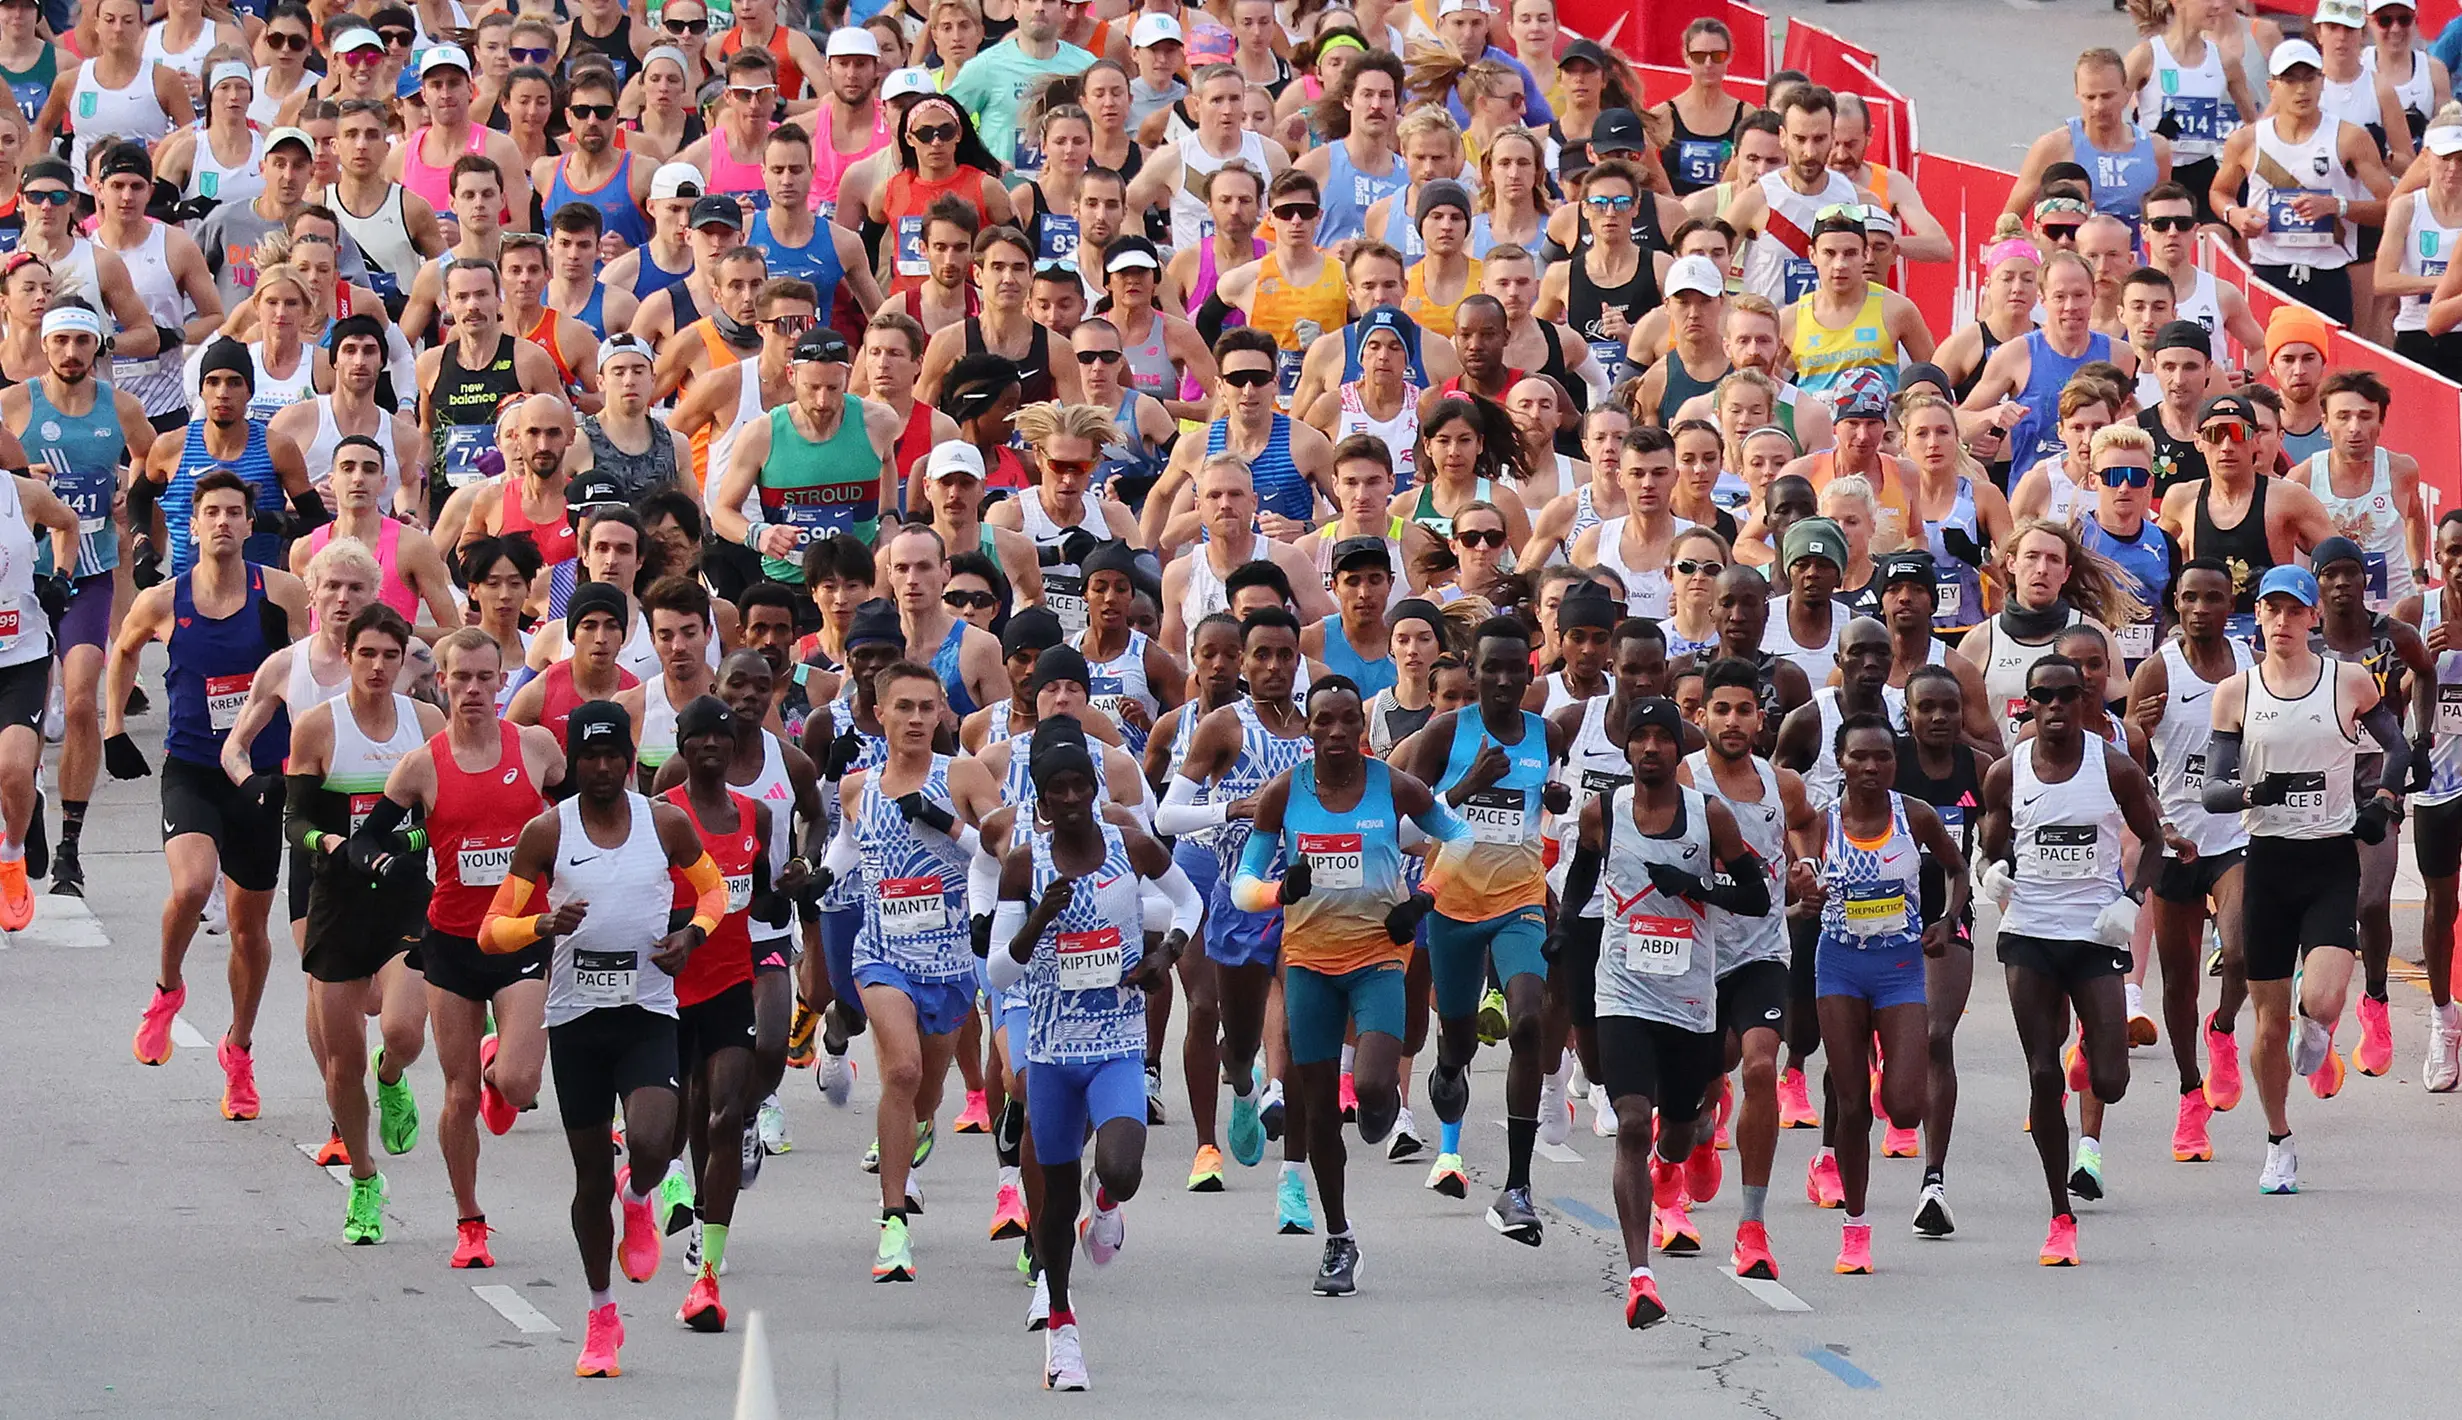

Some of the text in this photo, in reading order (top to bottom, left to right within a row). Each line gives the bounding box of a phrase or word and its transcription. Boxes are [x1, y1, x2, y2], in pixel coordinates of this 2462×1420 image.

[461, 382, 485, 394] new
[449, 393, 498, 405] balance
[783, 486, 864, 506] STROUD
[1046, 596, 1073, 610] ACE
[2114, 627, 2140, 639] ACE
[2255, 711, 2279, 721] ZAP
[2313, 793, 2323, 806] 8
[1466, 806, 1521, 826] PACE 5
[2040, 846, 2095, 862] PACE 6
[1309, 855, 1359, 871] IPTOO
[882, 896, 941, 917] MANTZ
[1639, 937, 1679, 956] ABDI
[1060, 950, 1120, 969] KIPTUM
[575, 970, 630, 987] PACE 1
